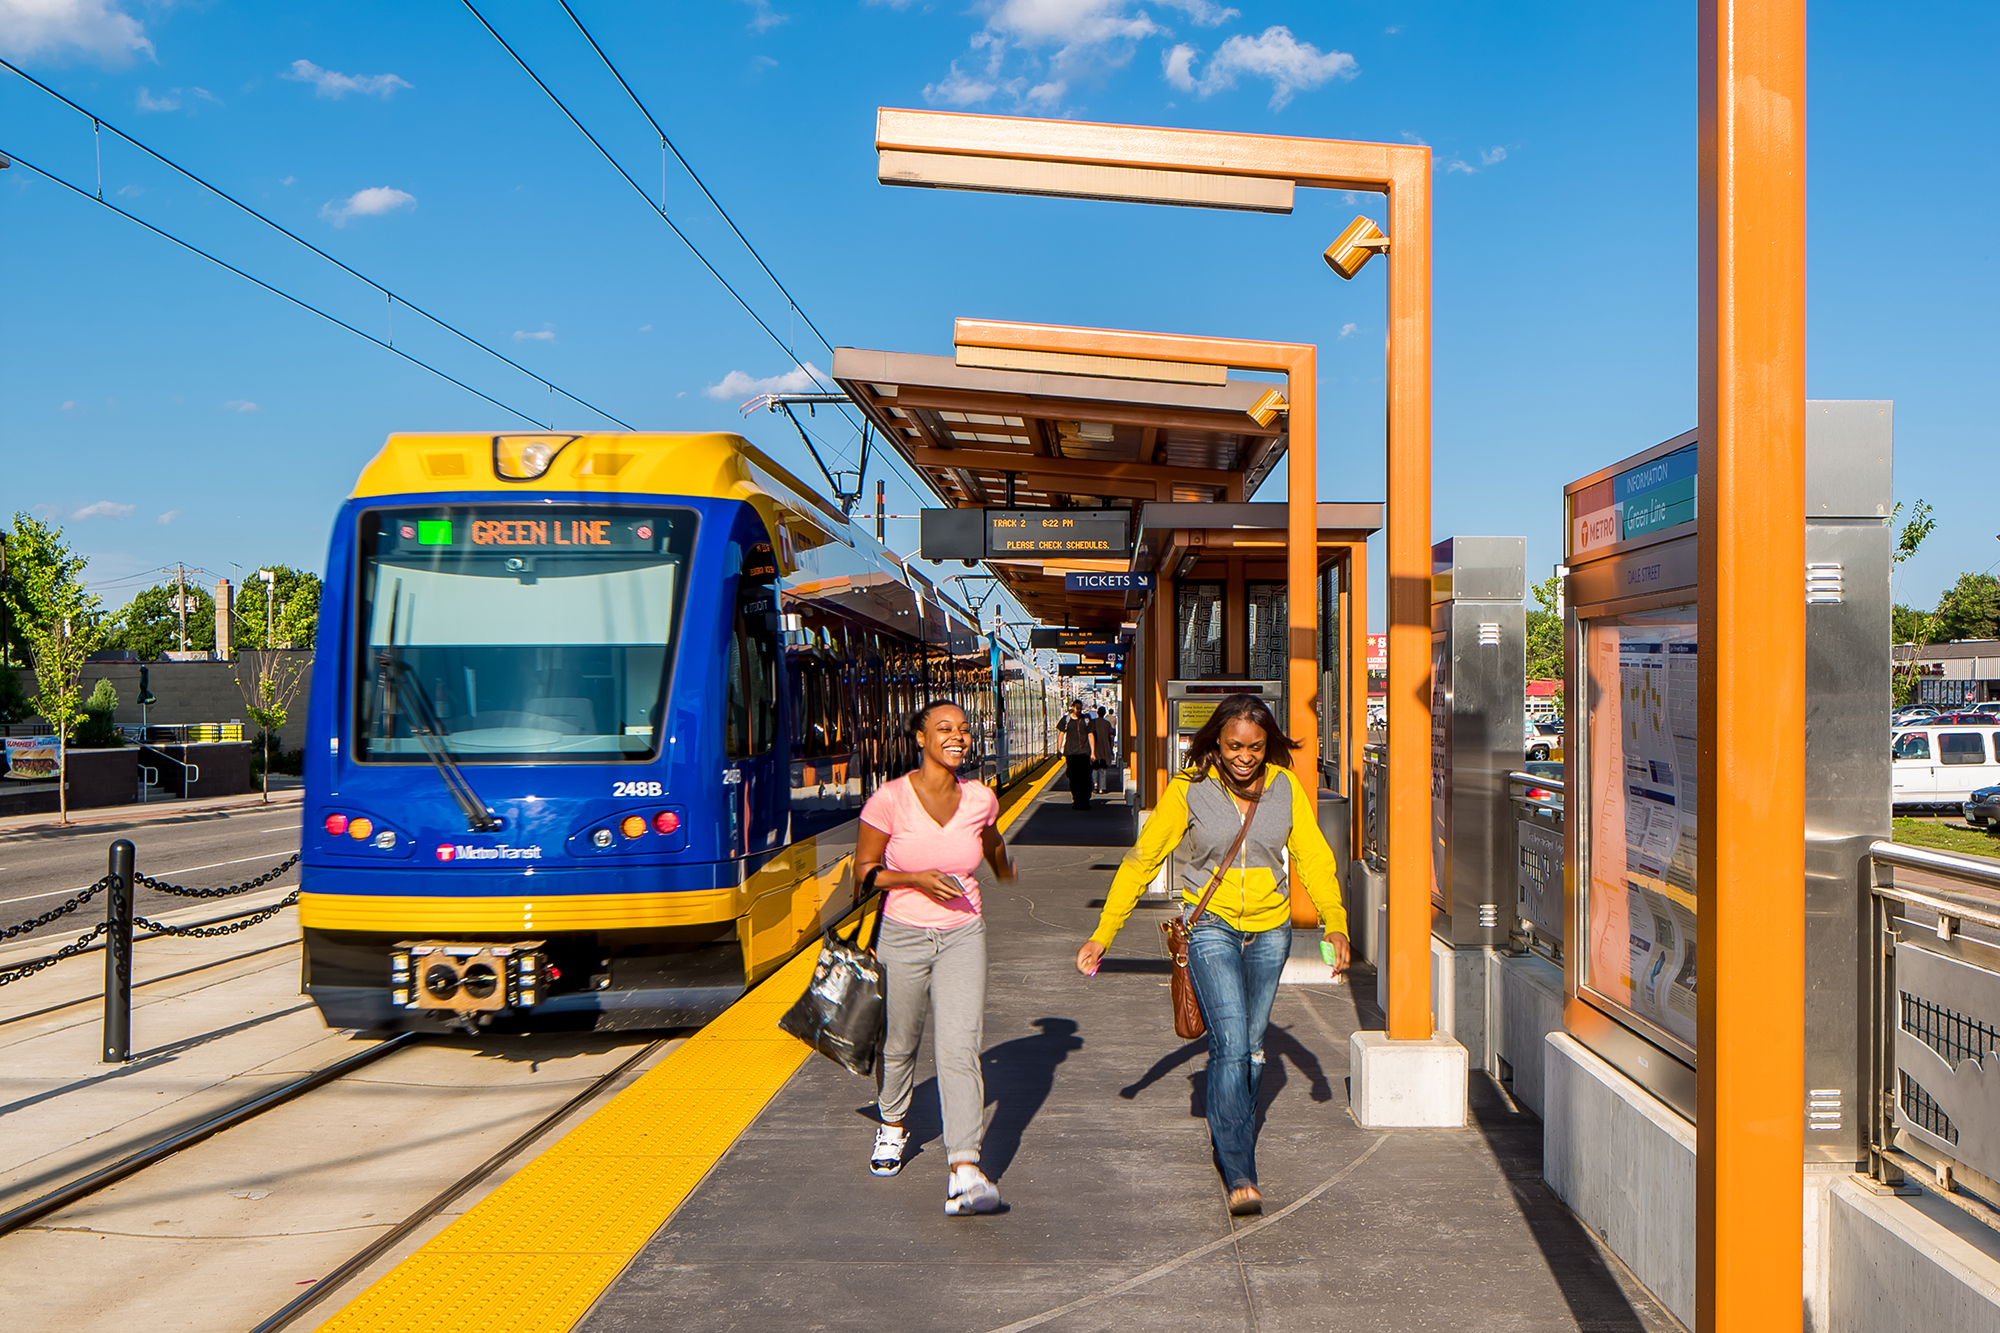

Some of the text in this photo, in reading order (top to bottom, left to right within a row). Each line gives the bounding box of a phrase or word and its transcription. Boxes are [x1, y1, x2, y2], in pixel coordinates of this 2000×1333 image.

[1626, 462, 1669, 494] INFORMATION
[993, 519, 1074, 528] TRACK 2 6:22 PM
[1627, 498, 1666, 531] Green Line
[472, 520, 612, 545] GREEN LINE
[1589, 516, 1614, 541] METRO
[1006, 541, 1110, 550] PLEASE CHECK SCHEDULES.
[1076, 575, 1131, 587] TICKETS
[1627, 563, 1661, 585] DALE STREET
[612, 781, 663, 797] 248B
